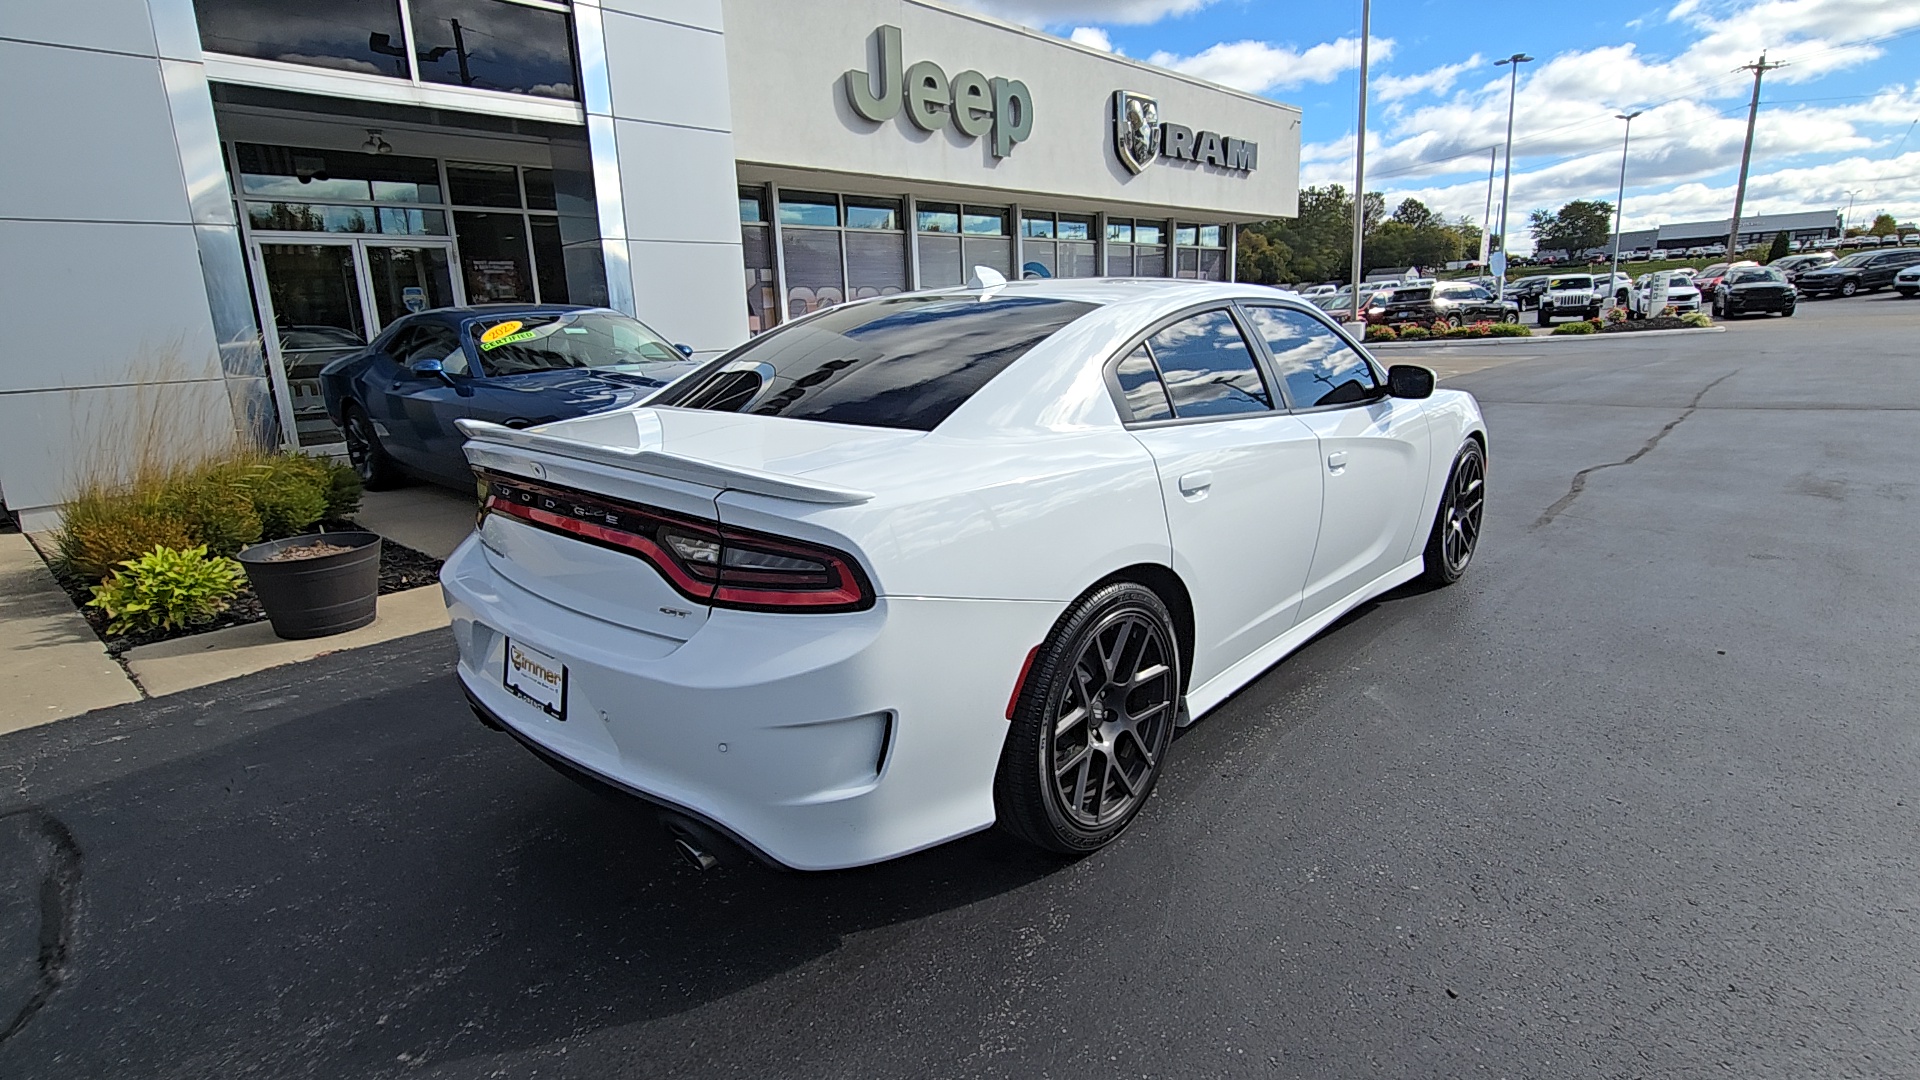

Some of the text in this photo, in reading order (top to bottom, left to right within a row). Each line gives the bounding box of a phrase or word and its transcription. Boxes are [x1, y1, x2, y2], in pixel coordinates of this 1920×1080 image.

[844, 24, 1034, 157] Jeep
[1159, 122, 1259, 171] RAM
[483, 331, 534, 350] CERTIFIED
[489, 323, 516, 340] 2023
[502, 487, 618, 525] DODGE
[511, 645, 562, 687] Zimmer
